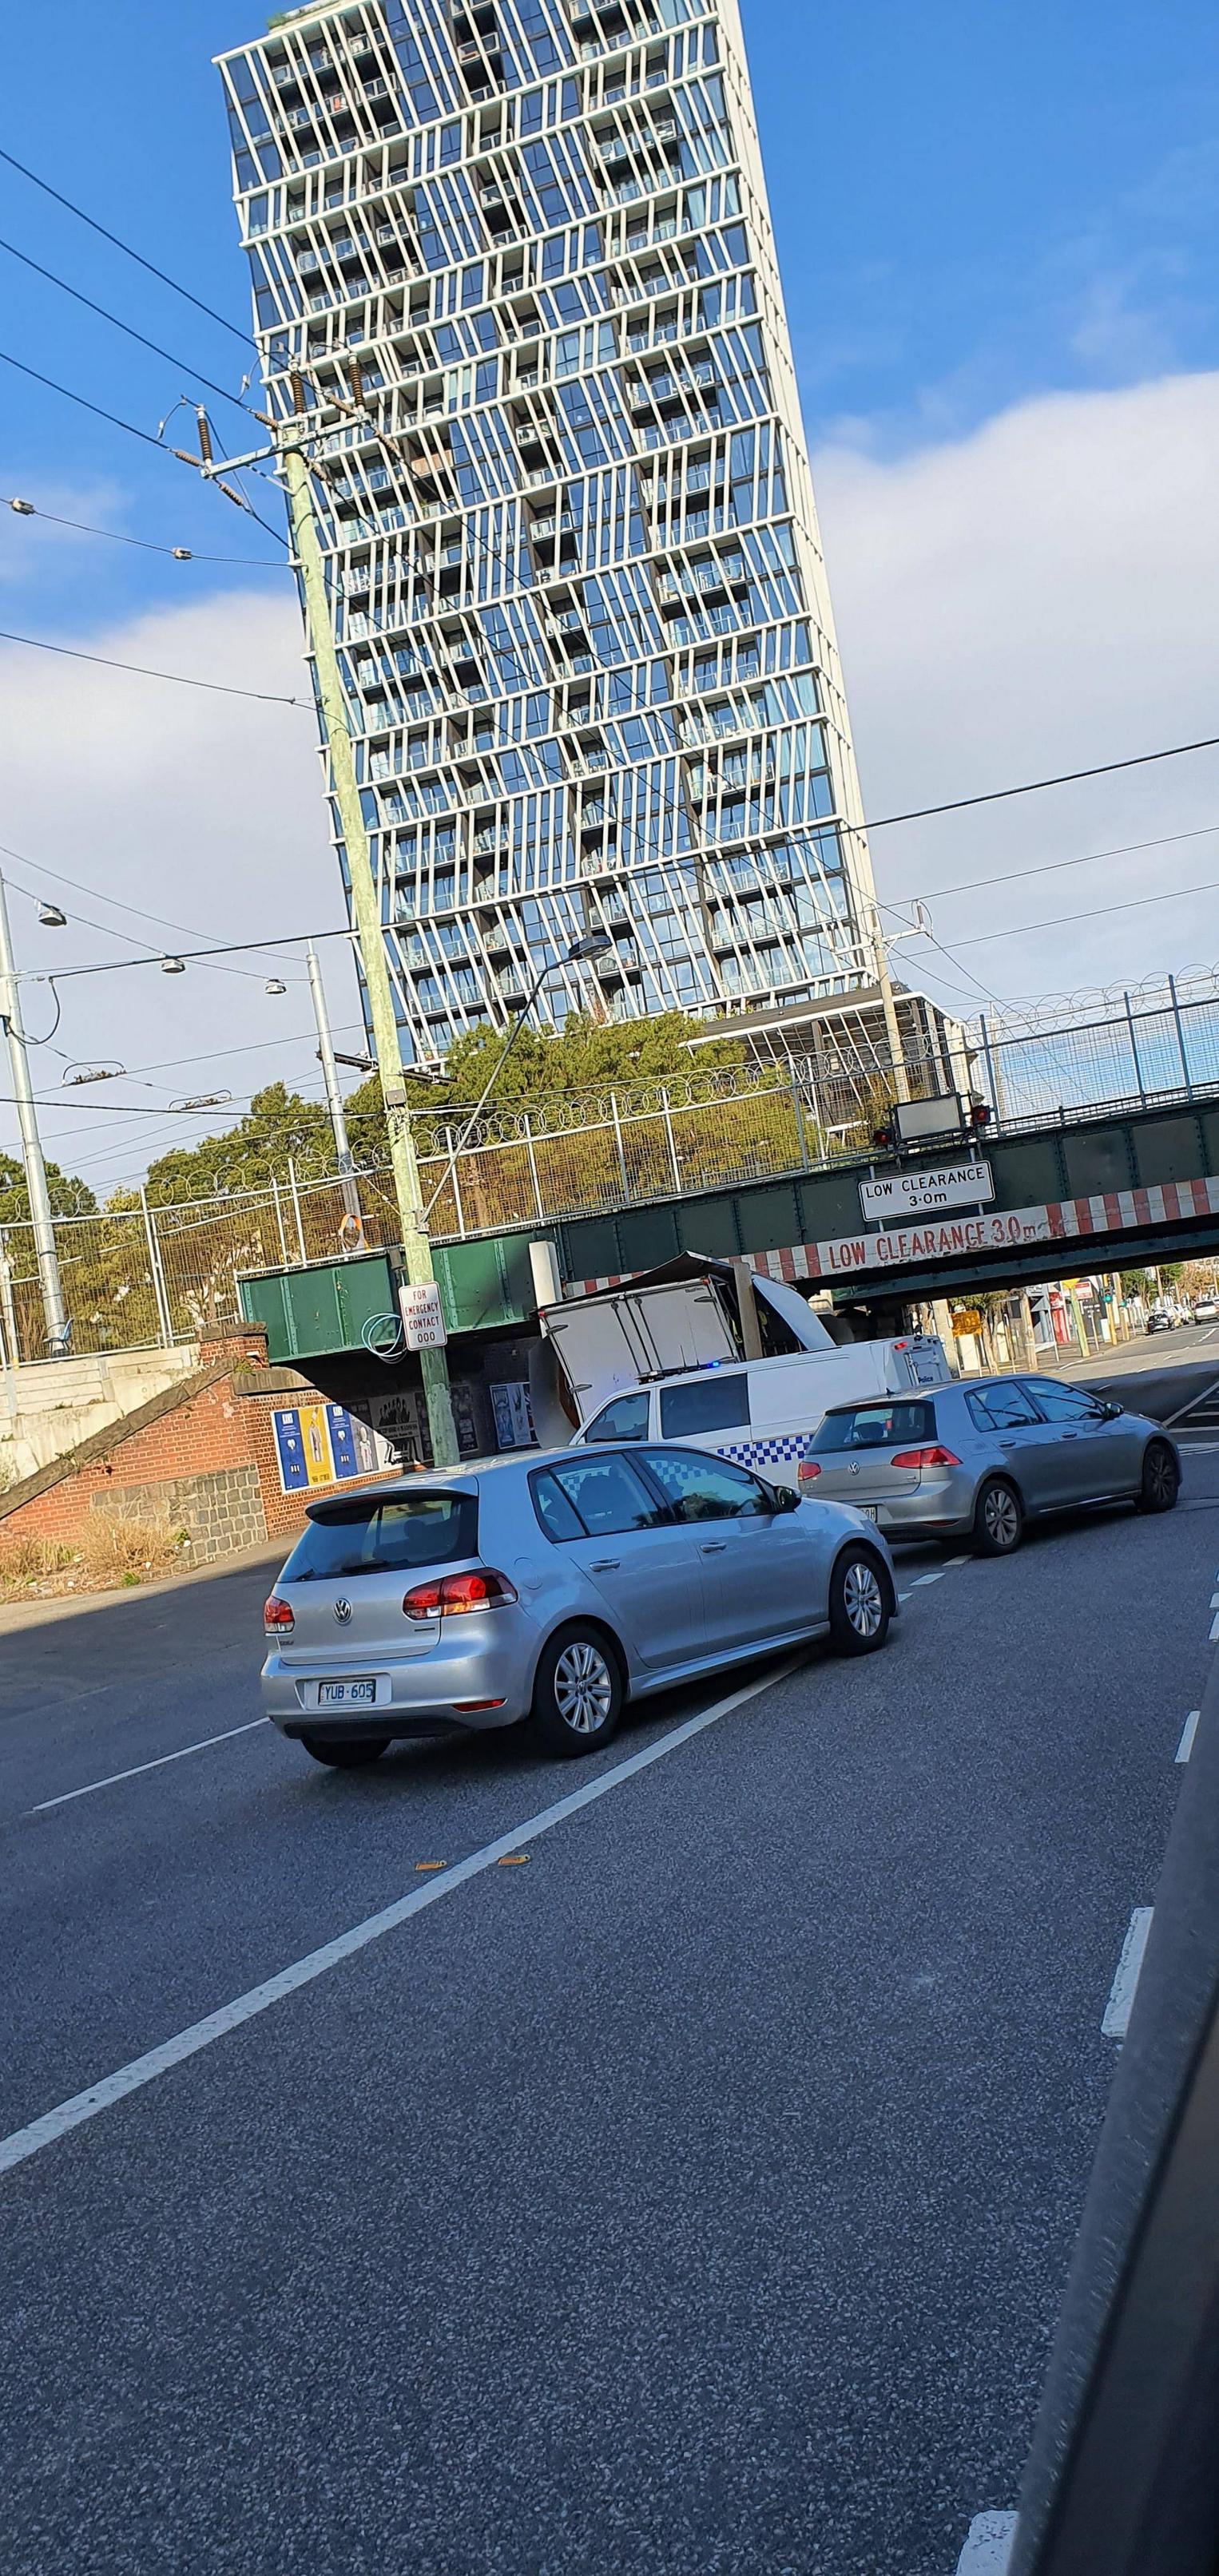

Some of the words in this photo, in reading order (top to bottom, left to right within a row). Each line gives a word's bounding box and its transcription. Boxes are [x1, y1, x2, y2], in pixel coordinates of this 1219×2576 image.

[866, 1183, 892, 1198] LOW
[902, 1167, 985, 1191] CLEARANCE
[829, 1240, 866, 1269] LOW
[876, 1222, 987, 1261] CLEARANCE
[413, 1290, 427, 1300] FOR
[405, 1302, 439, 1317] EMERGENCY
[409, 1316, 439, 1330] CONTACT
[417, 1331, 435, 1343] 000
